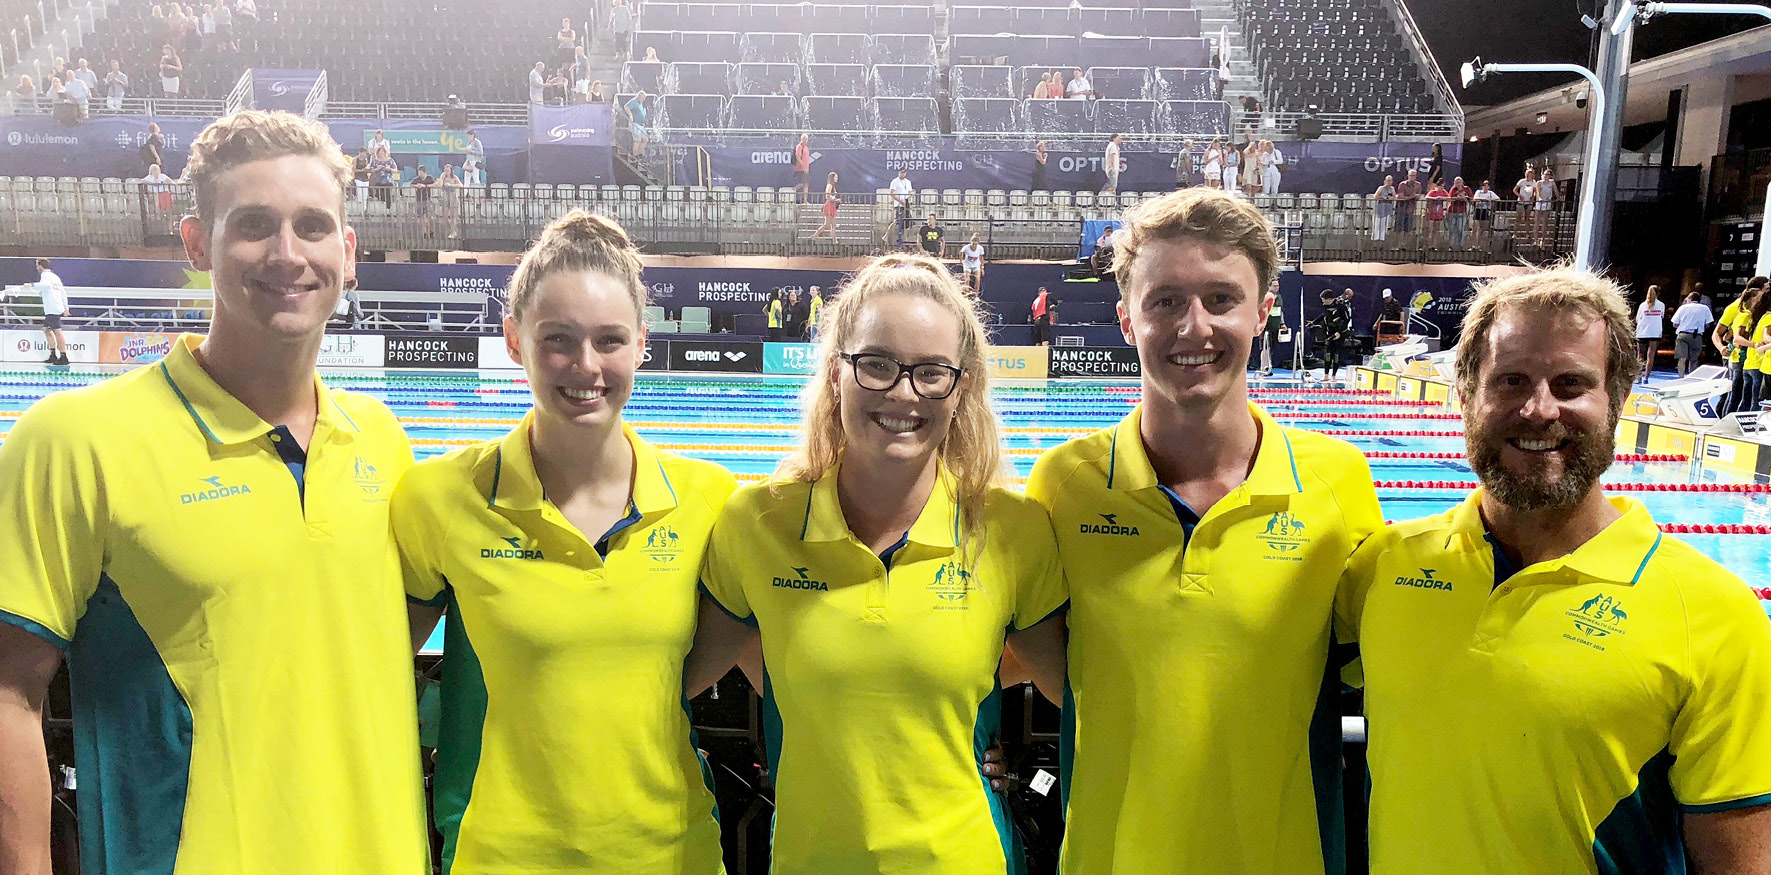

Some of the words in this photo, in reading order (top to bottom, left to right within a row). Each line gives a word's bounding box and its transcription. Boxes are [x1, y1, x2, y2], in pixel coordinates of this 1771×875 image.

[24, 133, 78, 145] lululemon
[136, 132, 178, 148] fiit
[751, 151, 791, 164] arena
[886, 150, 940, 161] HANCOCK
[886, 160, 963, 171] PROSPECTING
[1364, 156, 1434, 173] OPTUS
[440, 277, 492, 288] HANCOCK
[698, 282, 751, 292] HANCOCK
[120, 341, 170, 362] DOLPHINS
[388, 340, 449, 351] HANCOCK
[388, 351, 475, 362] PROSPECTING
[685, 350, 720, 362] arena
[1052, 351, 1112, 362] HANCOCK
[987, 357, 1027, 369] PTUS
[1051, 362, 1139, 373] PROSPECTING
[1700, 403, 1709, 416] 5
[181, 484, 251, 505] DIADORA
[1080, 524, 1140, 536] DIADORA
[480, 548, 545, 560] DIADORA
[772, 577, 829, 592] DIADORA
[1394, 576, 1453, 592] DIADORA
[1564, 611, 1608, 628] COMMONWEALTH
[1562, 633, 1577, 641] GOLD
[1576, 637, 1593, 647] COAST
[1592, 643, 1606, 652] 2018
